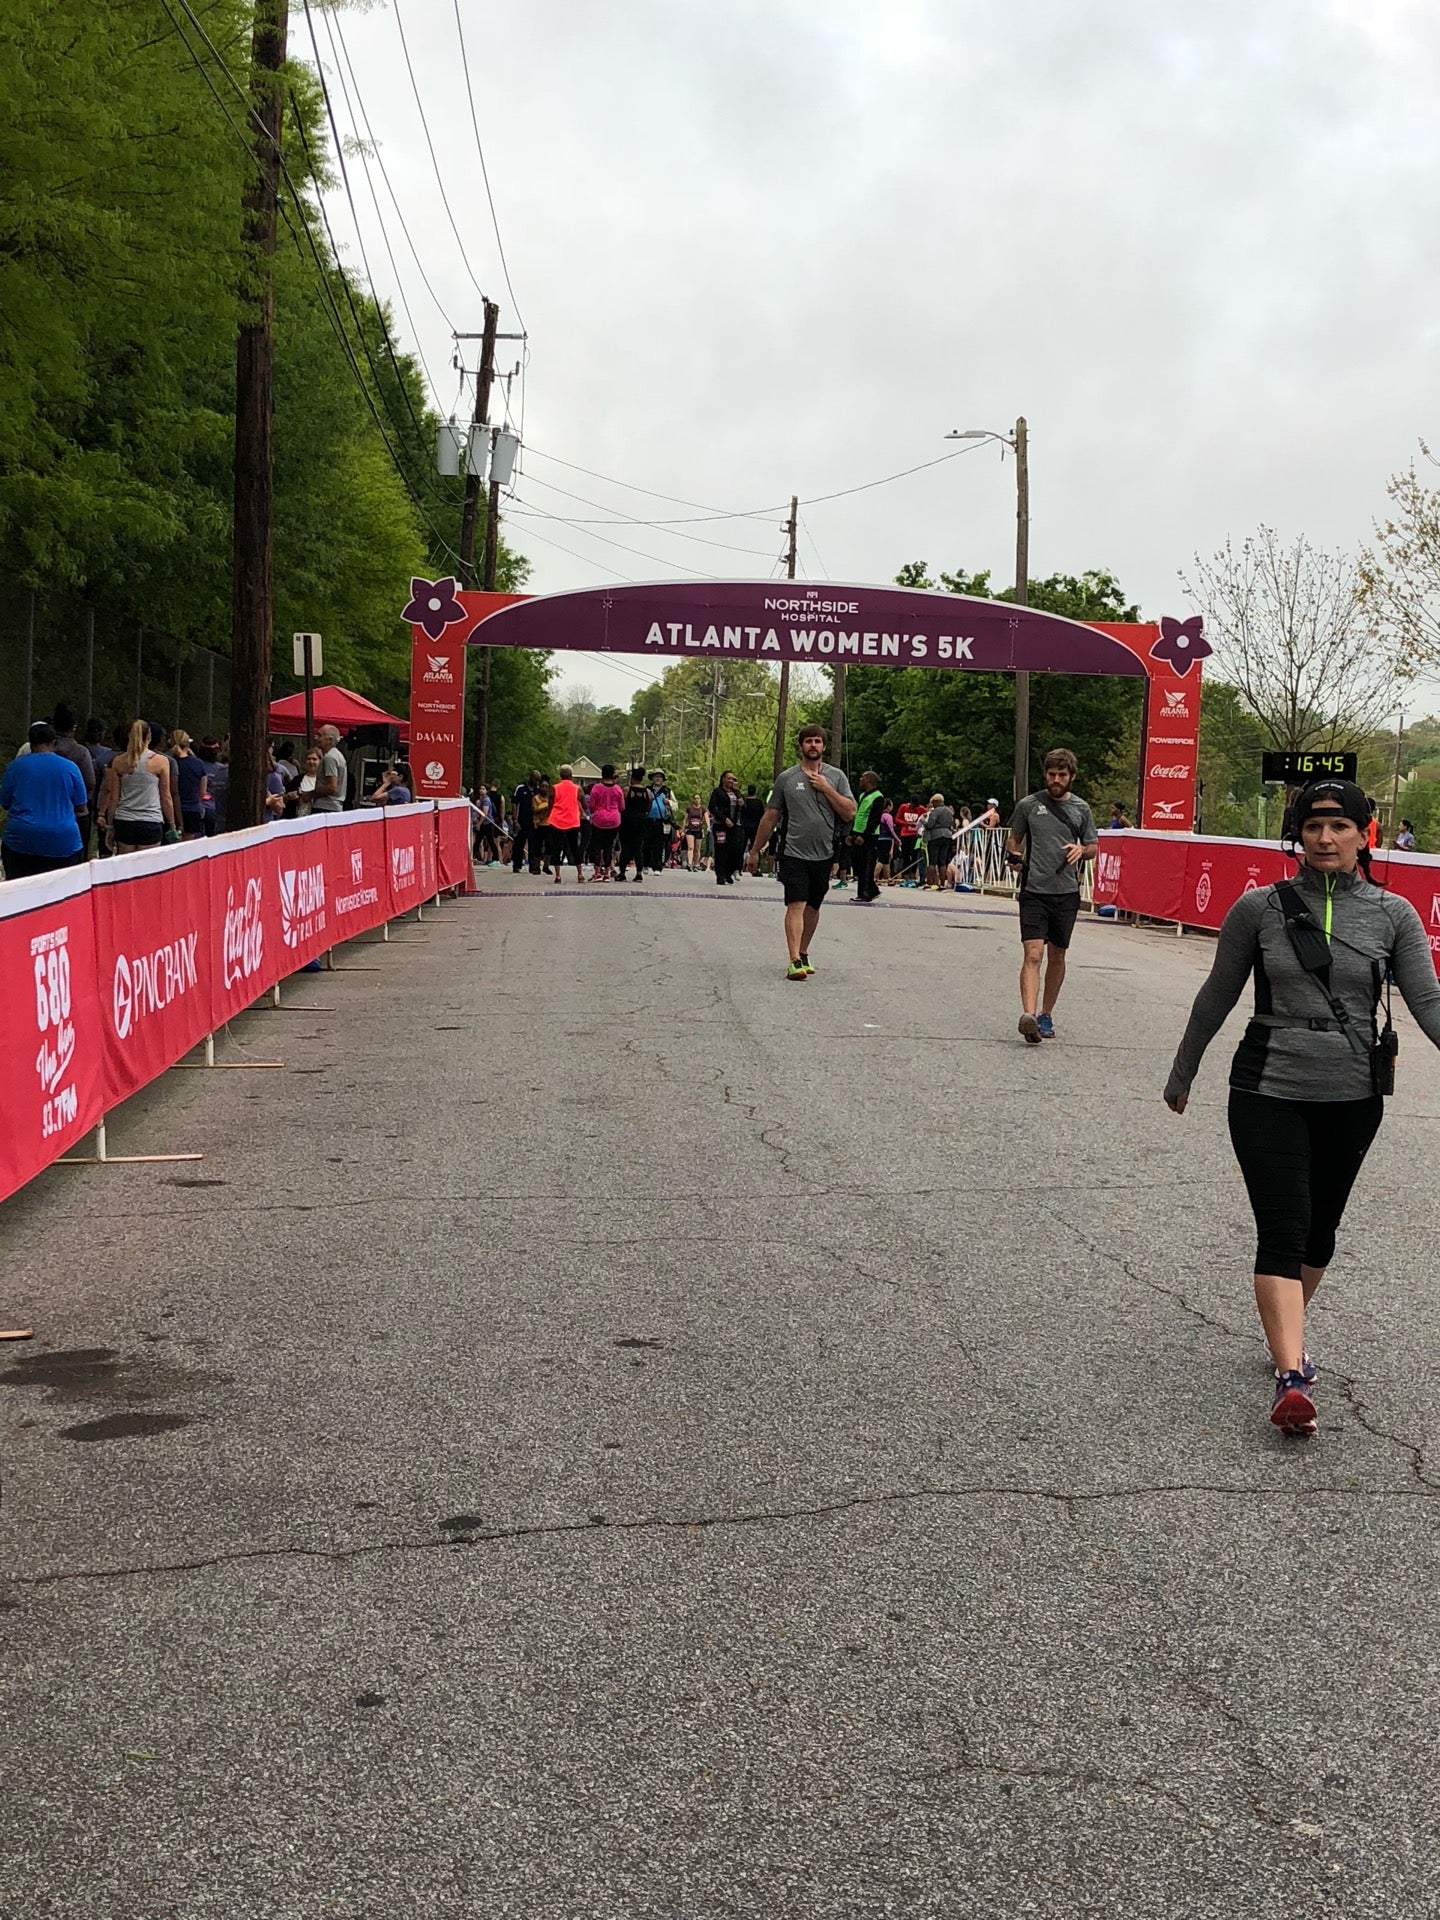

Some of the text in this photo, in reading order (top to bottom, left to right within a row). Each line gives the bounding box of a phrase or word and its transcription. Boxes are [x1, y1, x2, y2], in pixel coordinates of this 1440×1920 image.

[764, 598, 859, 614] NORTHSIDE
[781, 612, 841, 624] HOSPITAL
[645, 622, 975, 660] ATLANTA WOMEN'S 5K
[423, 672, 453, 681] ATLANTA
[1159, 706, 1189, 716] ATLANTA
[416, 731, 454, 743] DASANI
[1149, 736, 1195, 745] POWERADE
[296, 862, 326, 919] ATLANTA
[34, 945, 71, 1032] 680
